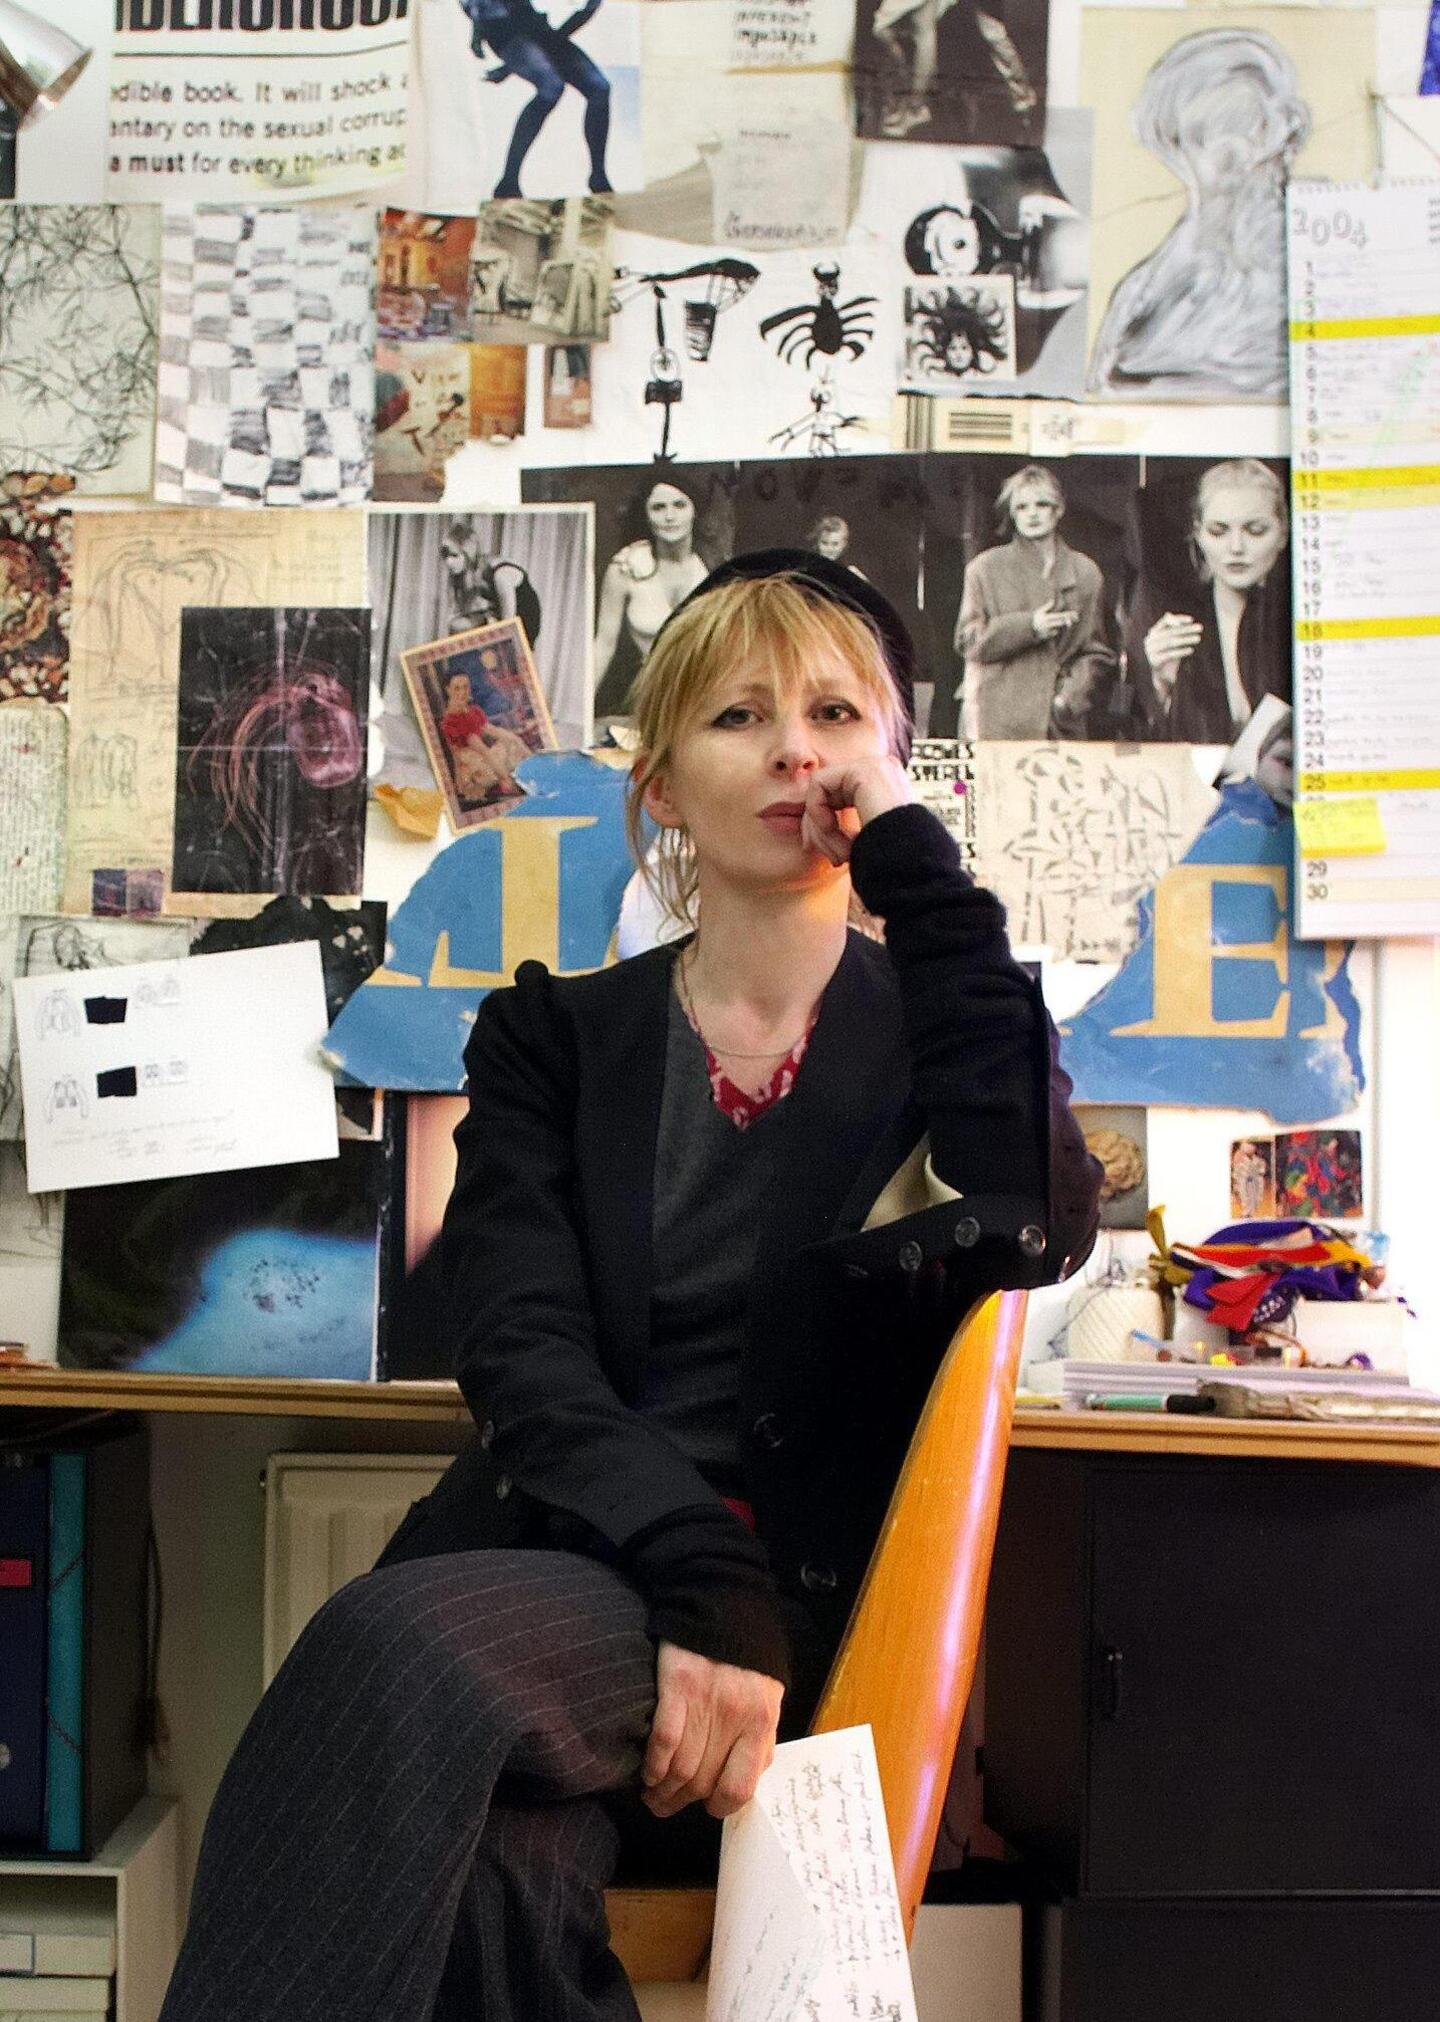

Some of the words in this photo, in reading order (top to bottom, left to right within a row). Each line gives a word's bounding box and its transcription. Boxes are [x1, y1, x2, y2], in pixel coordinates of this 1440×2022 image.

[256, 81, 271, 102] It
[283, 82, 321, 102] will
[332, 71, 391, 101] shock
[184, 120, 211, 138] on
[220, 116, 256, 138] the
[264, 115, 333, 139] sexual
[128, 153, 184, 173] must
[192, 153, 220, 173] for
[229, 158, 287, 178] every
[294, 146, 381, 174] thinking
[1308, 428, 1319, 442] 9
[1301, 451, 1319, 466] 10
[1301, 473, 1318, 488] 11
[1301, 494, 1319, 510] 12
[1302, 515, 1320, 530] 13
[1302, 537, 1320, 551] 14
[1302, 559, 1321, 574] 15
[1303, 581, 1321, 596] 16
[1304, 600, 1321, 616] 17
[1303, 622, 1322, 638] 18
[1304, 644, 1322, 659] 19
[1303, 666, 1323, 681] 20
[1303, 687, 1322, 703] 21
[1304, 709, 1324, 725] 22
[1304, 731, 1325, 746] 23
[1305, 752, 1325, 768] 24
[1306, 773, 1326, 791] 25
[1307, 860, 1328, 877] 29
[1307, 883, 1328, 900] 30
